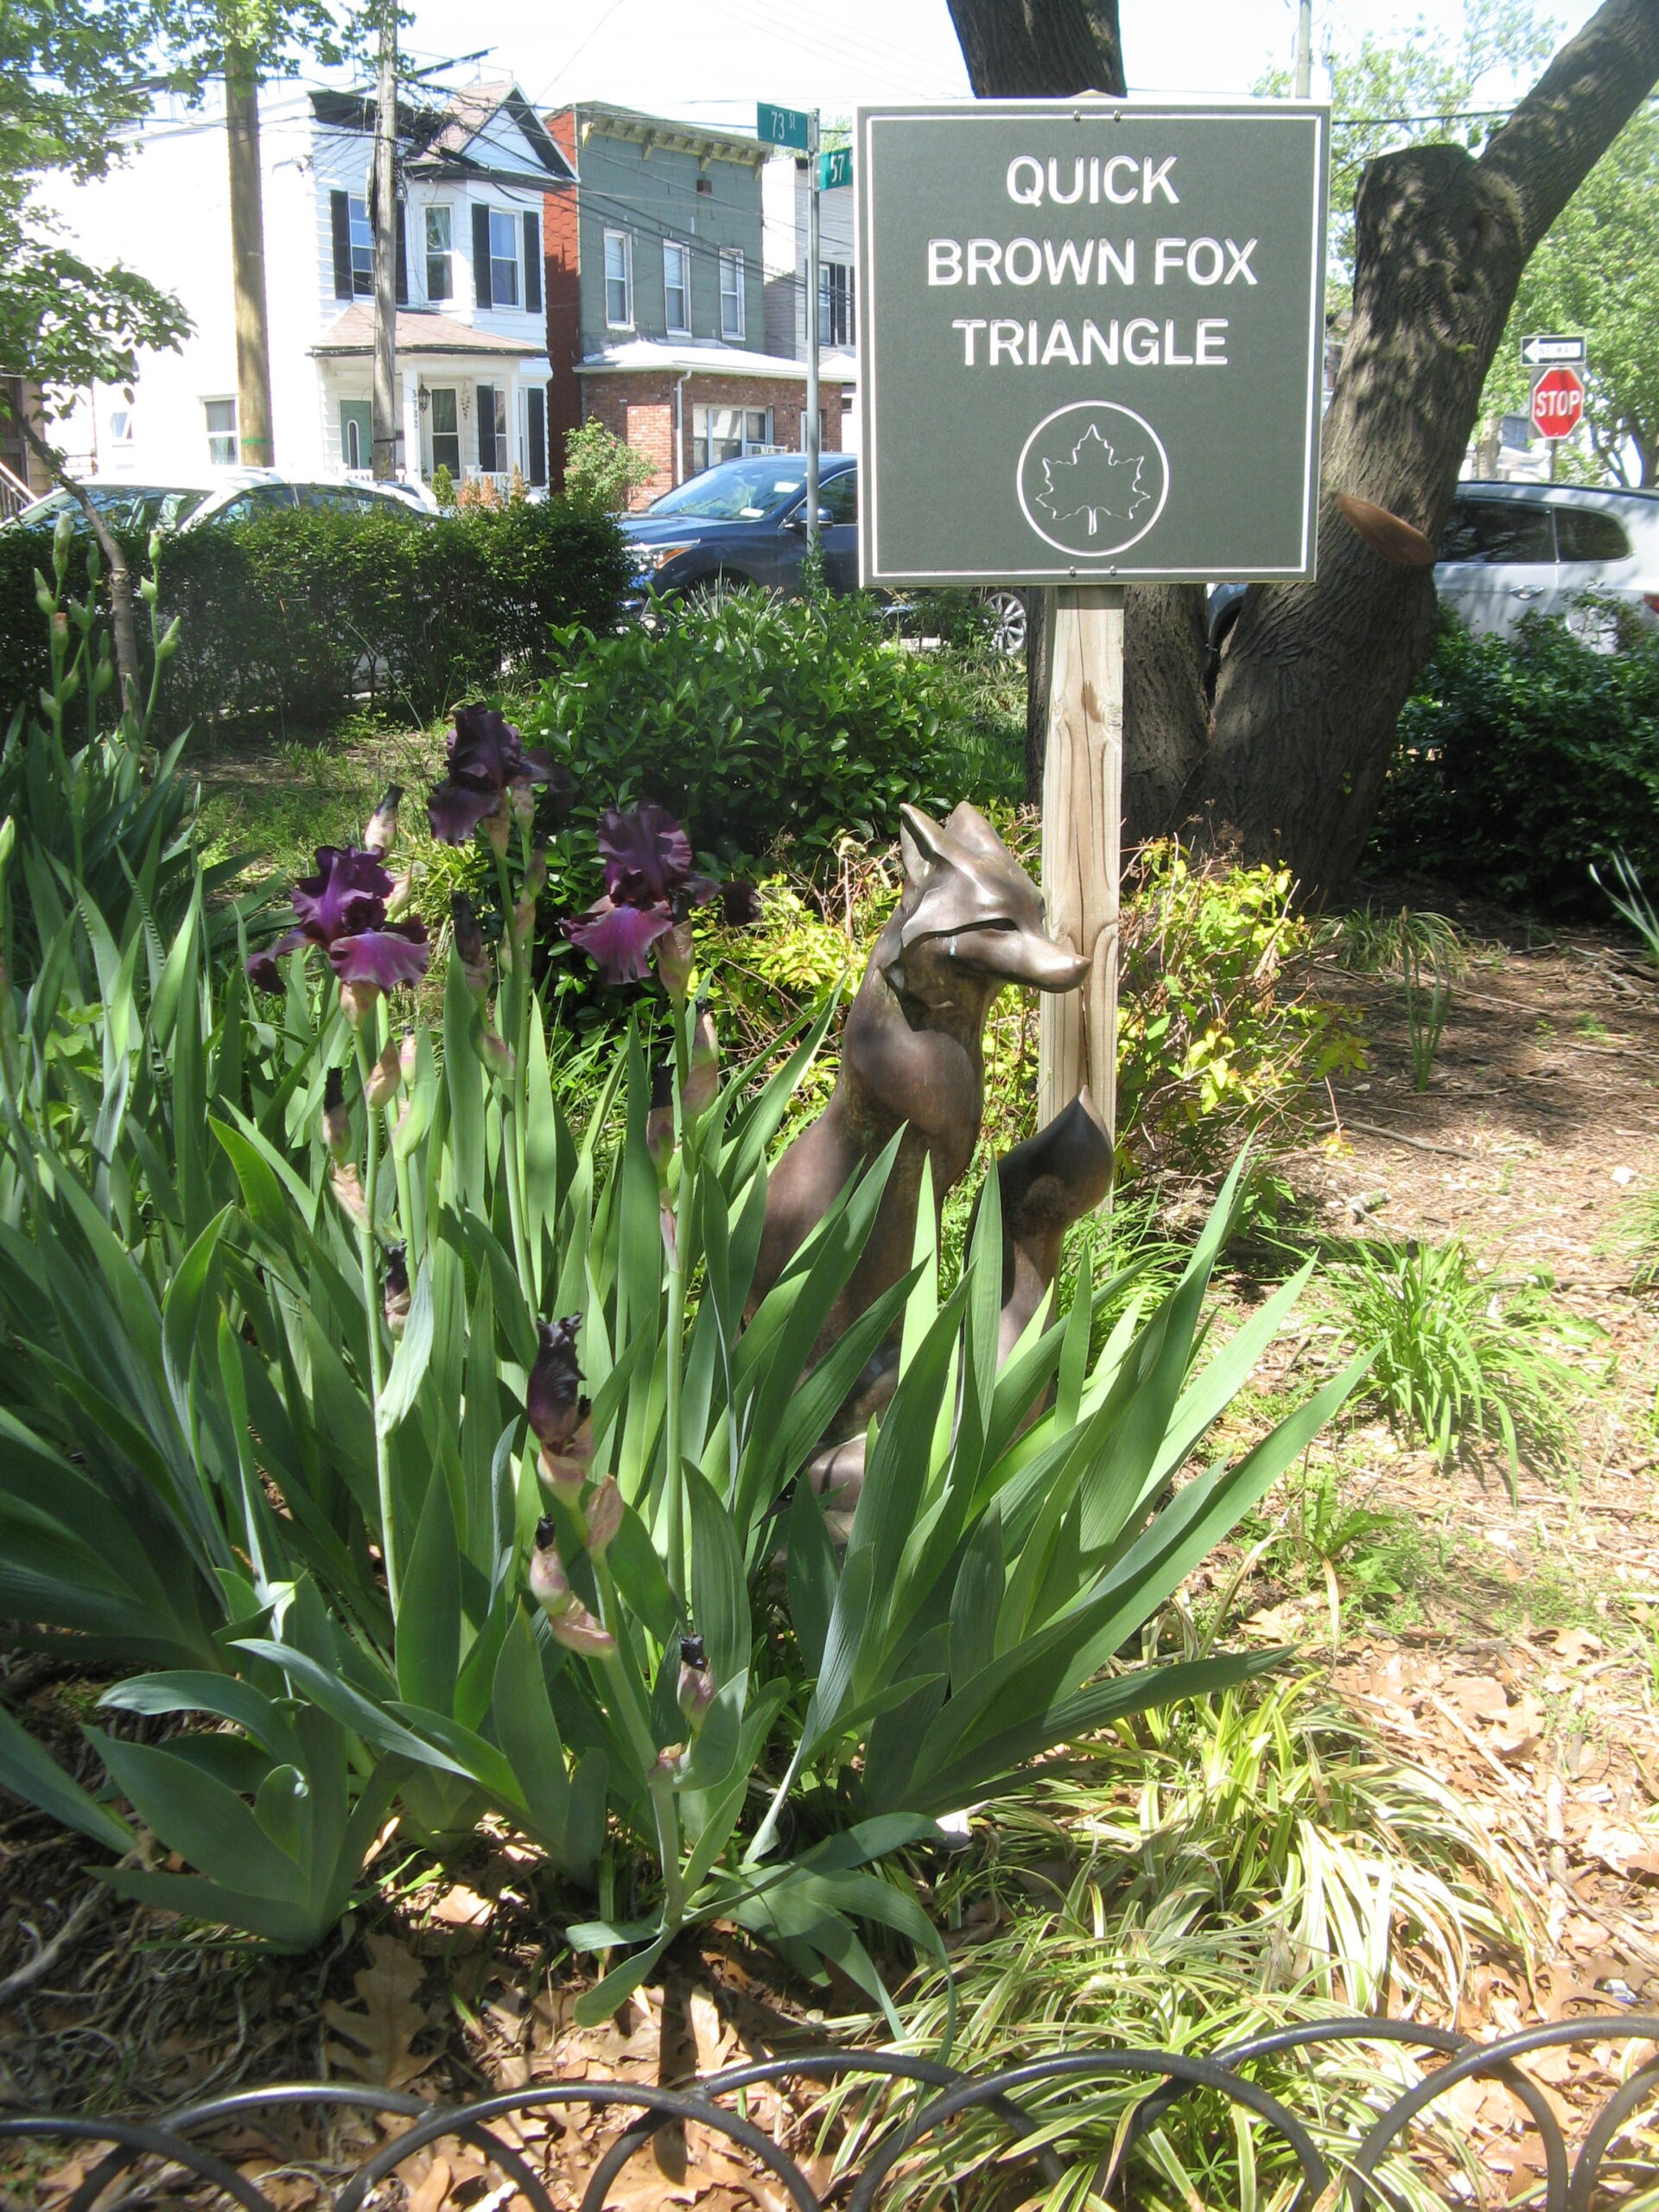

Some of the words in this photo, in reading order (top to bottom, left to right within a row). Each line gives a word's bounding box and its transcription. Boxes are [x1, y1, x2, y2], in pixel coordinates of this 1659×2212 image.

[771, 111, 785, 139] 73
[830, 154, 844, 182] 57
[1006, 155, 1180, 207] QUICK
[927, 238, 1135, 286] BROWN
[1154, 238, 1258, 285] FOX
[951, 318, 1229, 366] TRIANGLE
[1533, 345, 1551, 356] ONE
[1557, 345, 1576, 354] WAY
[1535, 390, 1580, 417] STOP
